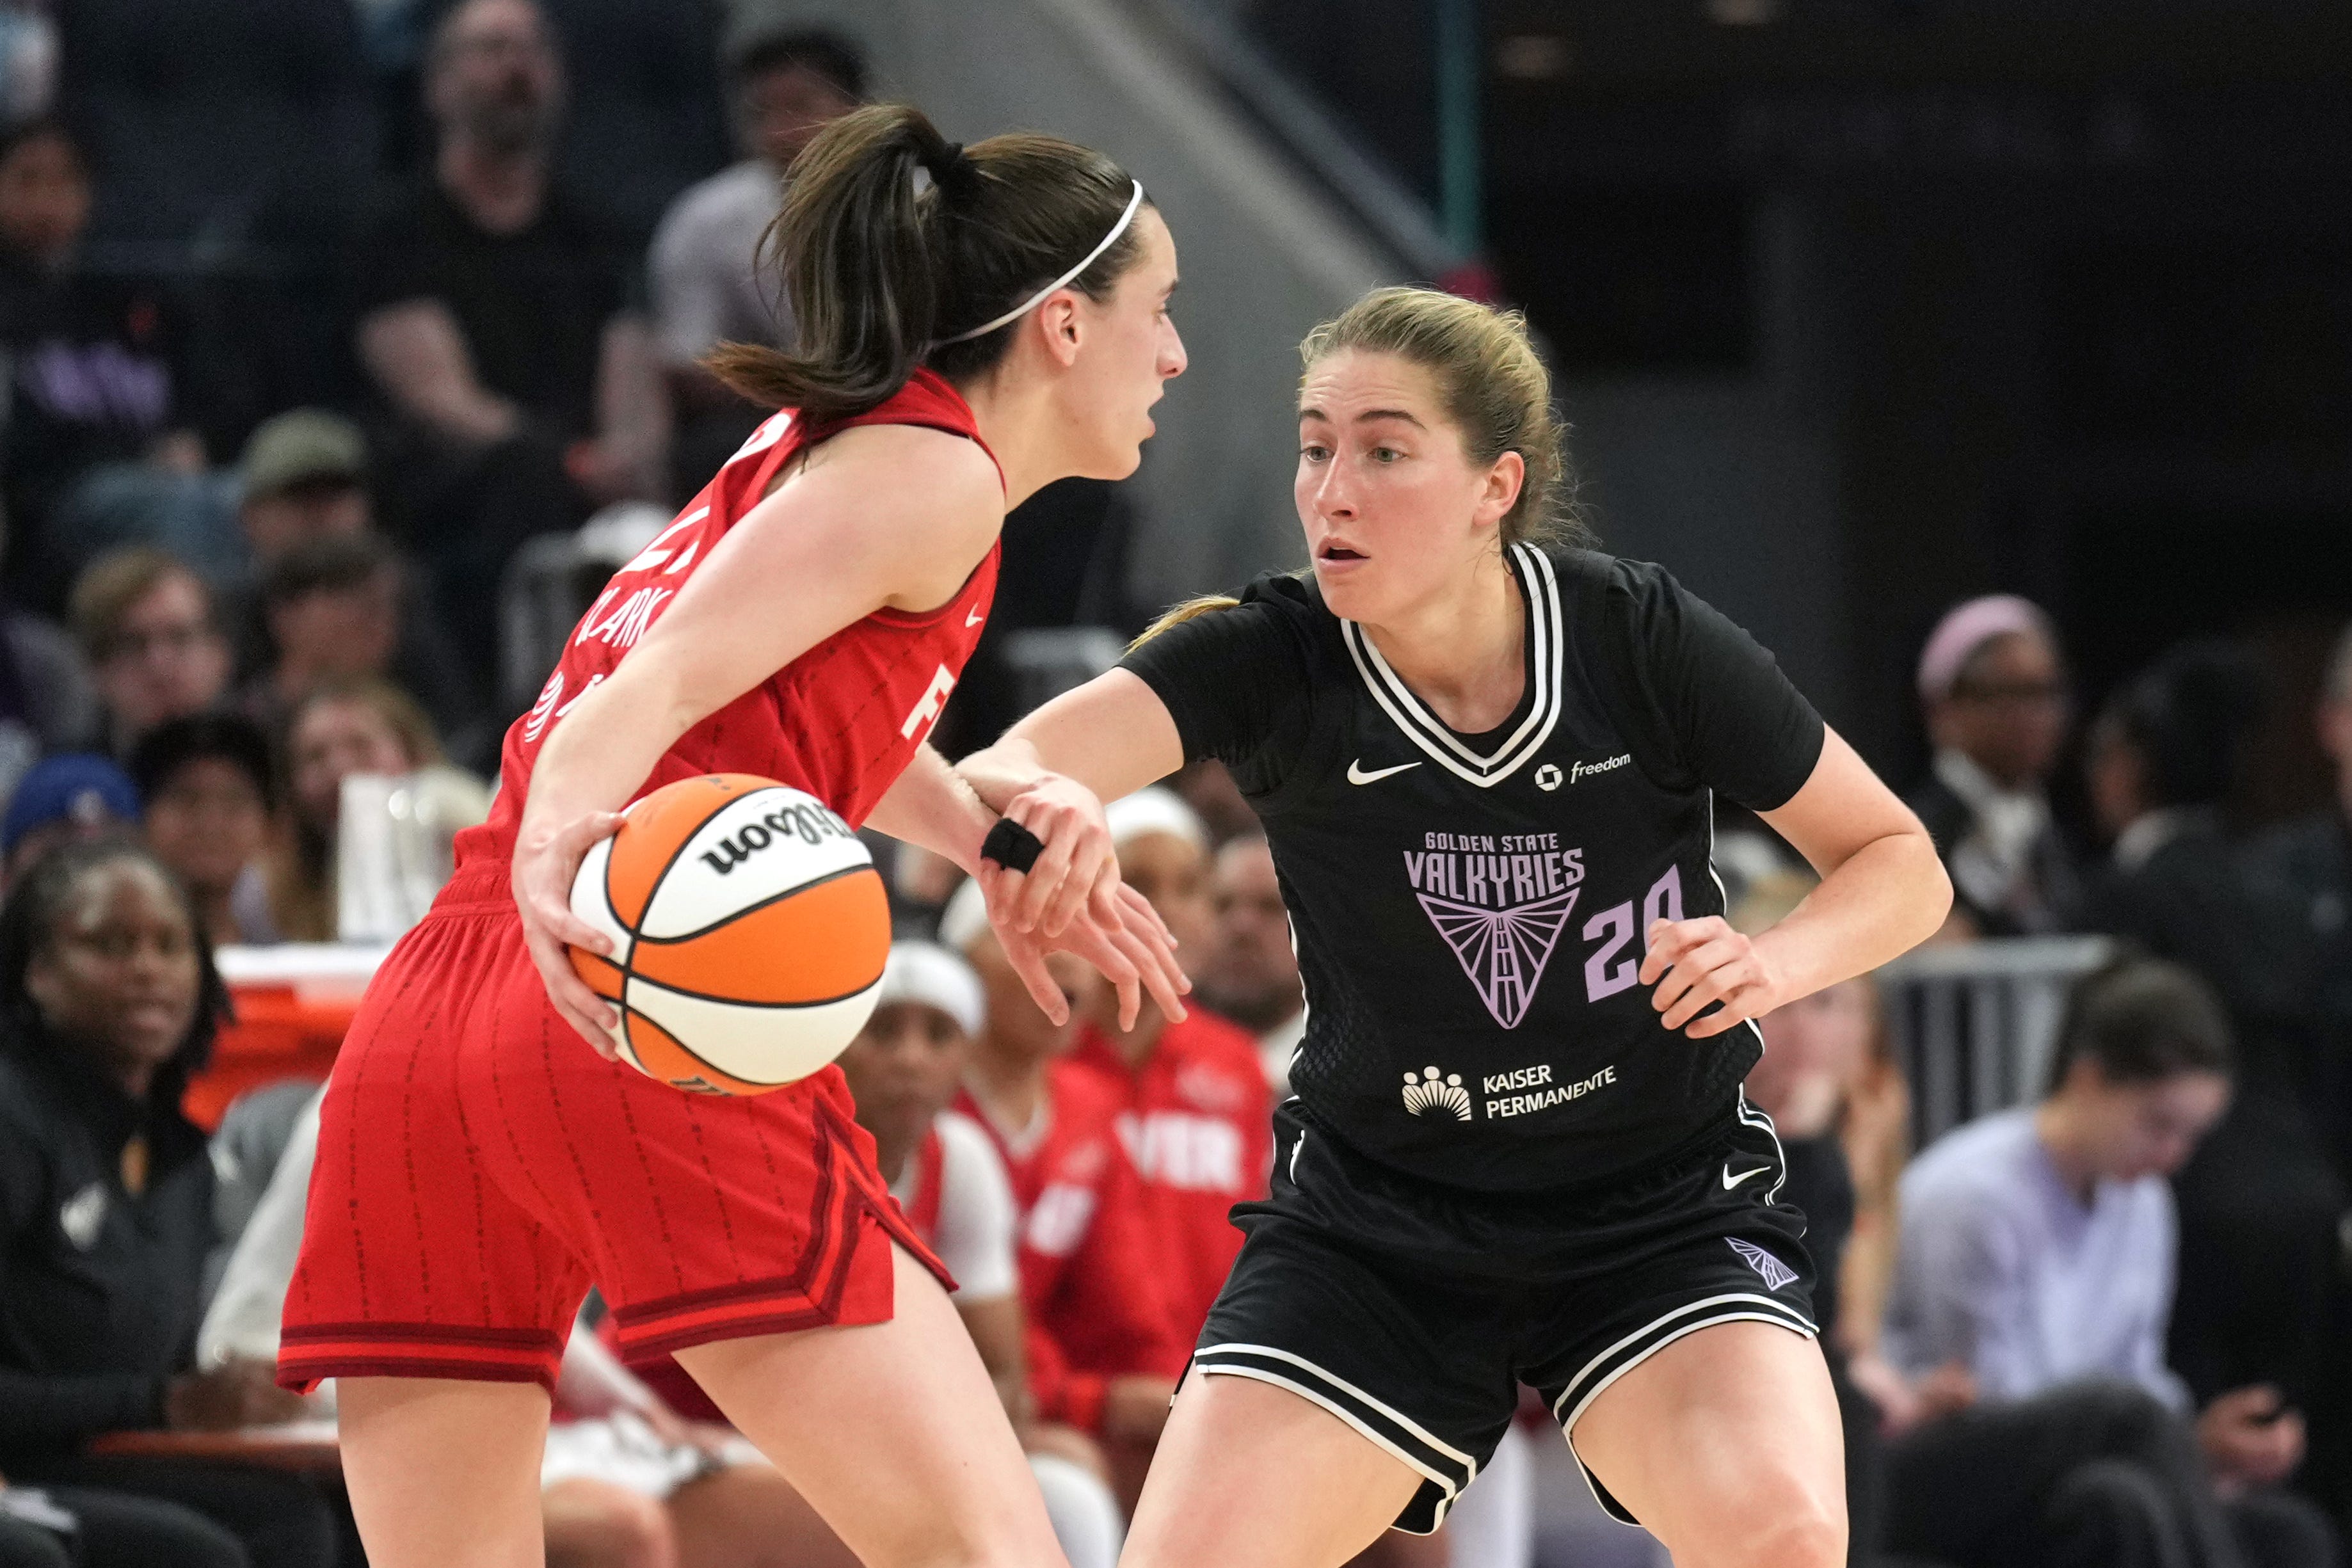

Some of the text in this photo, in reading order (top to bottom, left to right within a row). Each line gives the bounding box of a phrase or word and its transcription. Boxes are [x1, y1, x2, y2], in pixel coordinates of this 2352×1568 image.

[1570, 753, 1631, 784] freedom
[1425, 832, 1558, 852] GOLDEN STATE
[1403, 847, 1585, 908] VALKYRIES
[1483, 1065, 1552, 1094] KAISER
[1486, 1065, 1617, 1119] PERMANENTE
